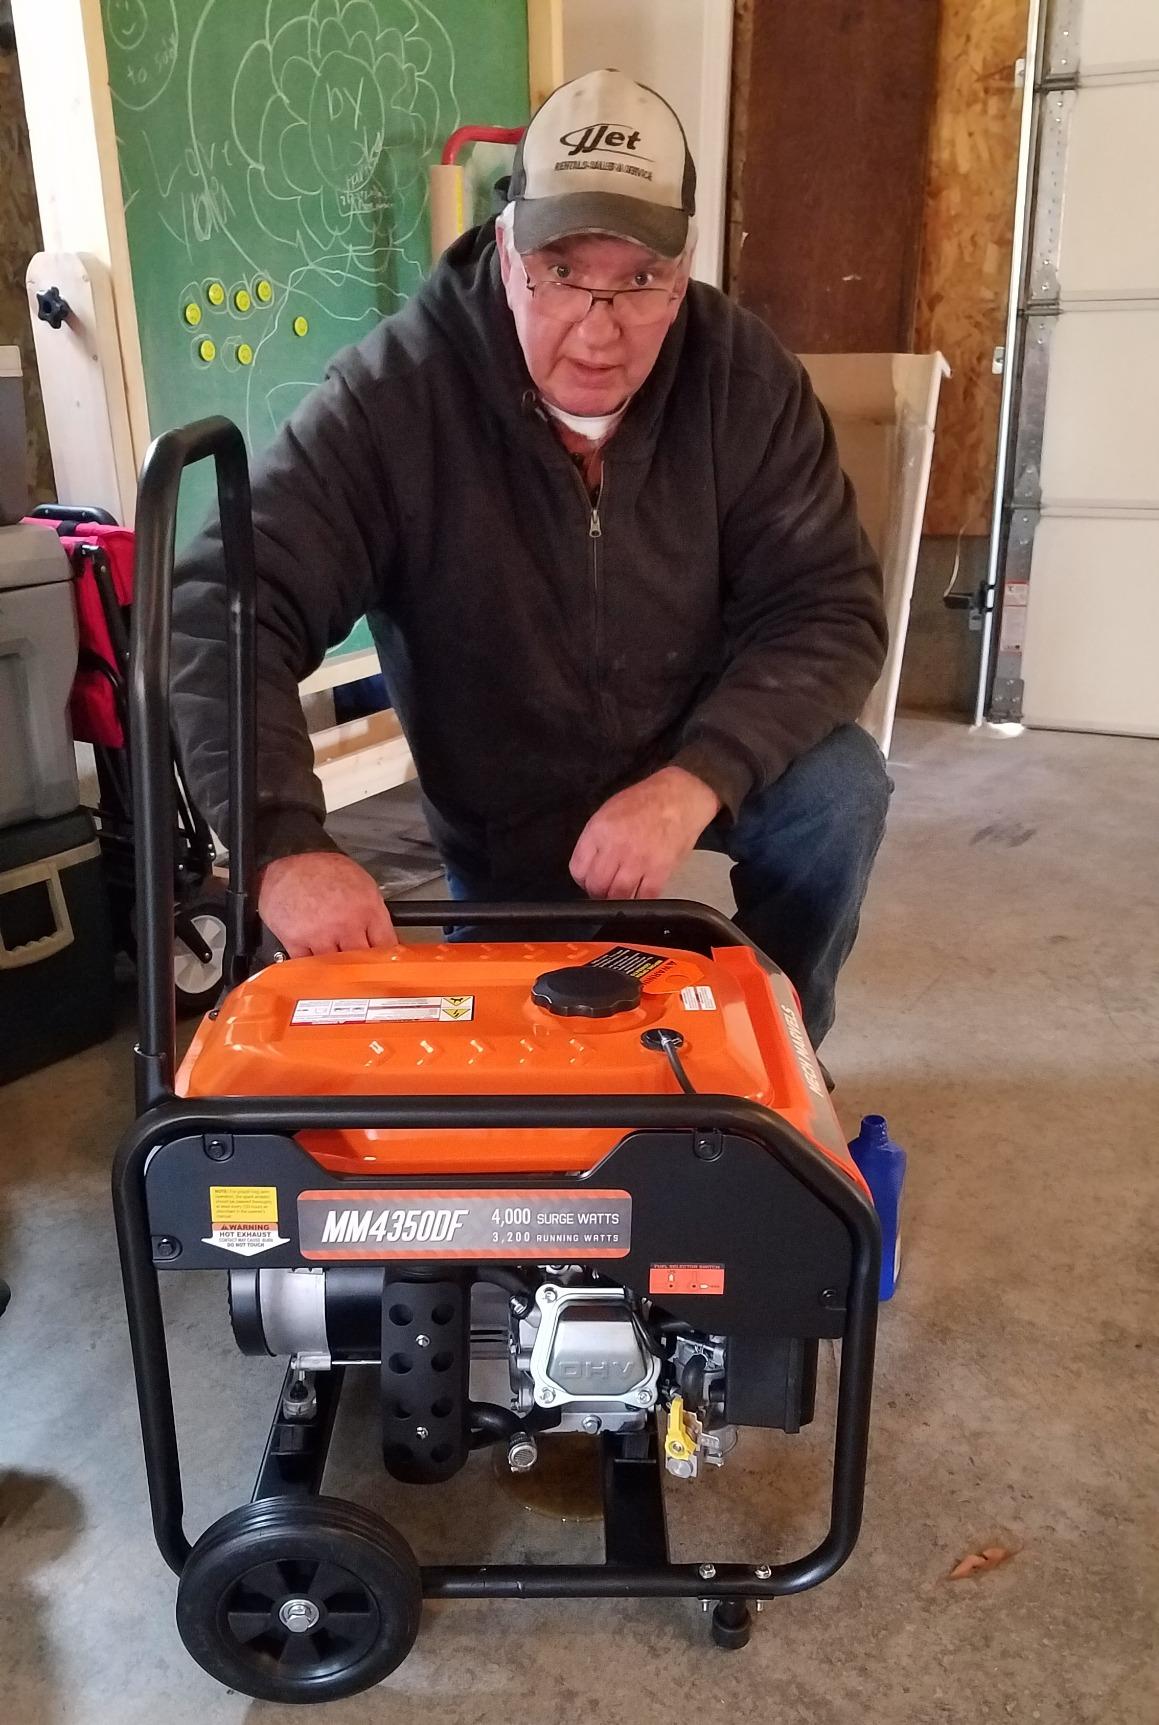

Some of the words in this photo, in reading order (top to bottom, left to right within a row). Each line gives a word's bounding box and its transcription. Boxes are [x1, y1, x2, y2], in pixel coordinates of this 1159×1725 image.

[321, 1208, 470, 1244] MM4350DF
[491, 1207, 532, 1228] 4,000
[536, 1212, 575, 1225] SURGE
[577, 1212, 620, 1225] WATTS
[491, 1231, 531, 1244] 3,200
[536, 1234, 579, 1243] RUNNING
[583, 1234, 620, 1243] WATTS
[557, 1359, 634, 1380] OHV
